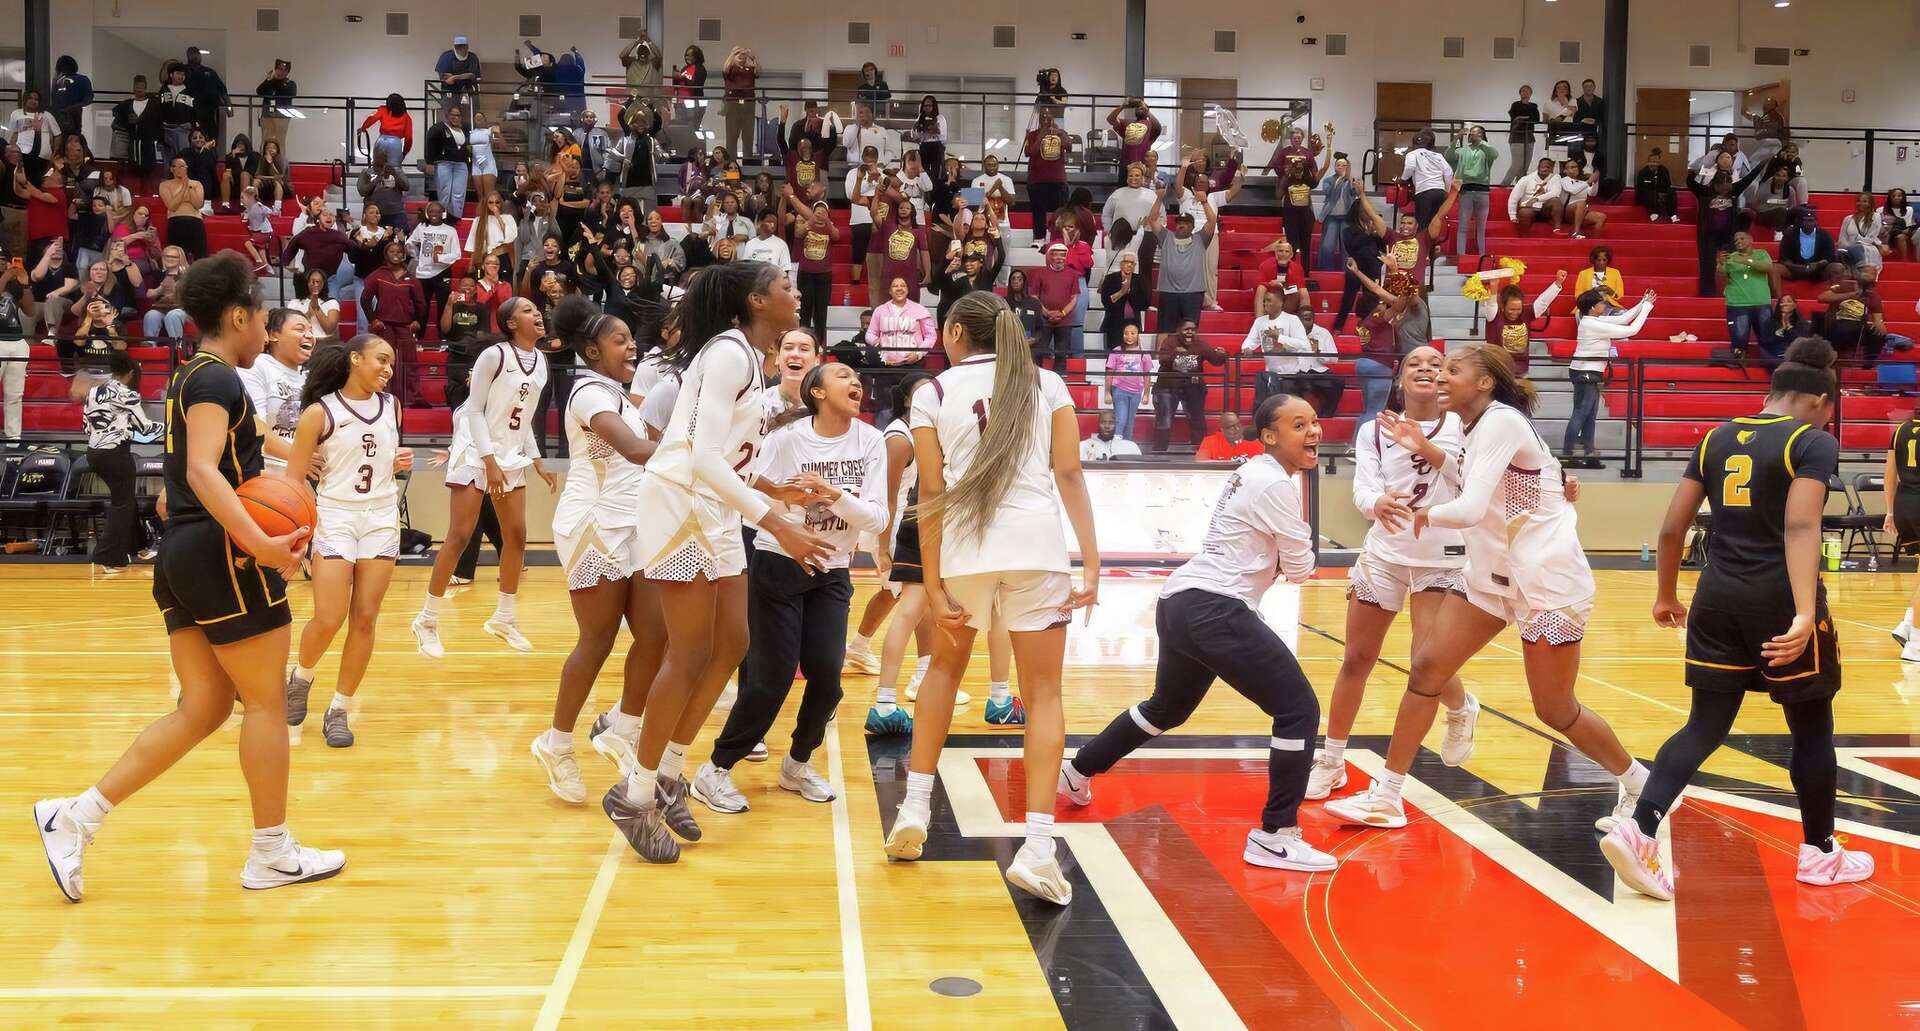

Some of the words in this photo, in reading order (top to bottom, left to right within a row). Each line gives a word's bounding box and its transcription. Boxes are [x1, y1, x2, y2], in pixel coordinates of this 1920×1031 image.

[509, 406, 523, 431] 5
[361, 433, 377, 458] SC
[354, 464, 374, 494] 3
[1723, 453, 1754, 508] 2
[1406, 482, 1430, 513] 2
